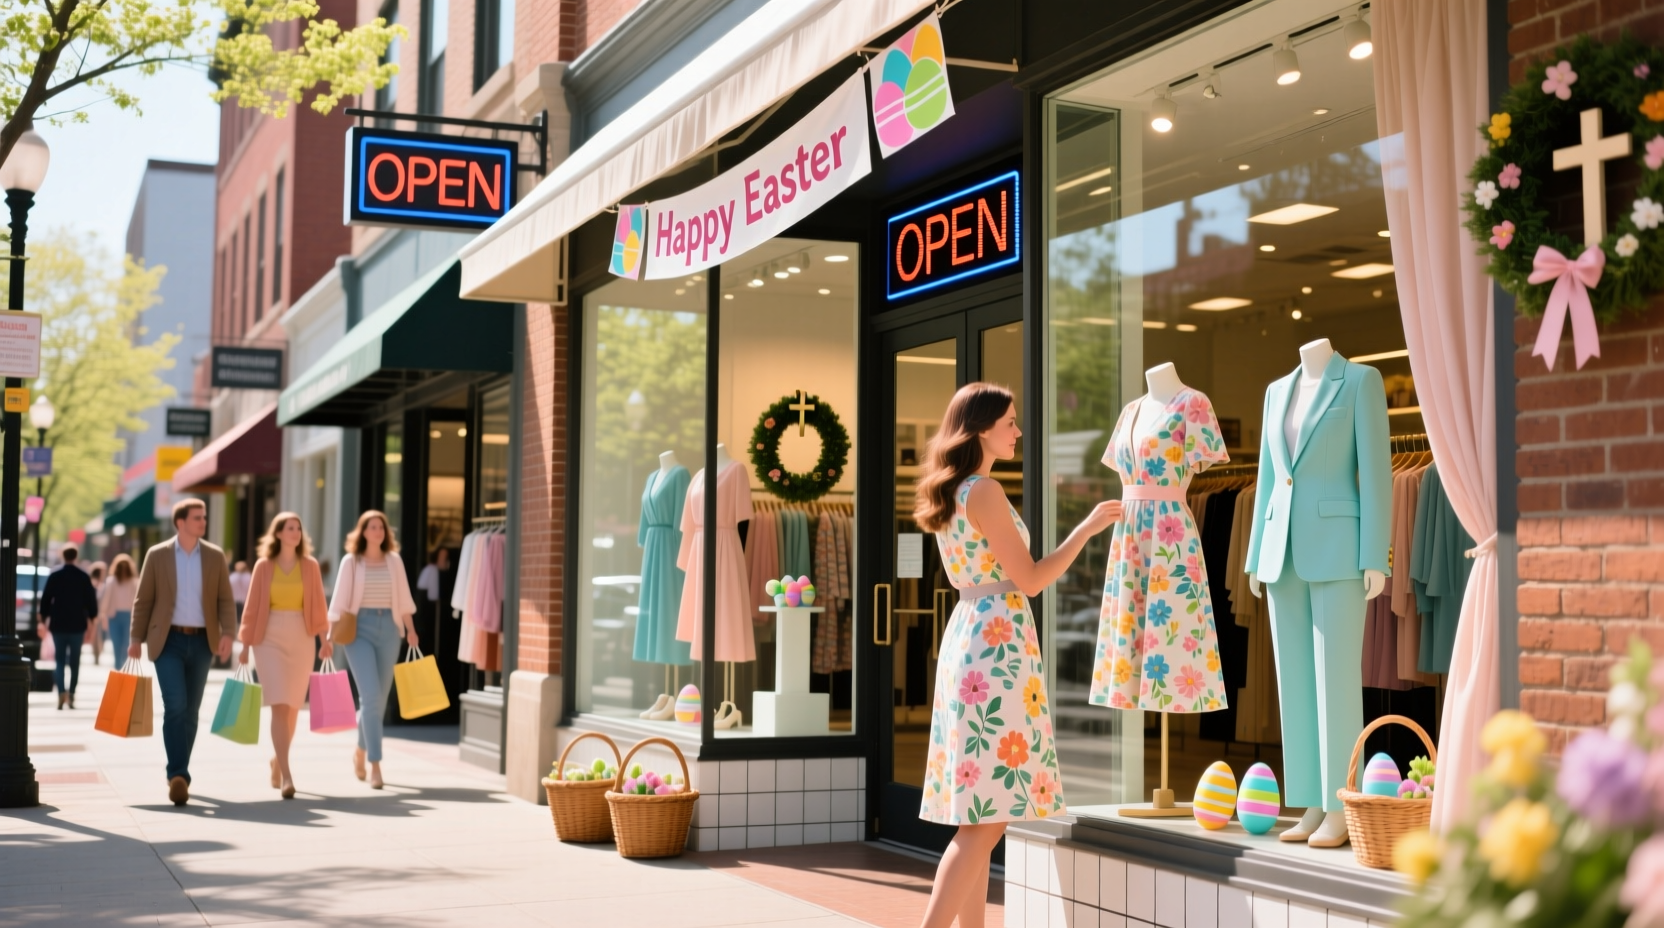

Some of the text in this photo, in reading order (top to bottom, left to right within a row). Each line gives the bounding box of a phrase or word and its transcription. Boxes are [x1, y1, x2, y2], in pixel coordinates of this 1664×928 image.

[367, 152, 501, 210] OPEN
[655, 125, 847, 267] Happy Easter
[895, 190, 1007, 282] OPEN
